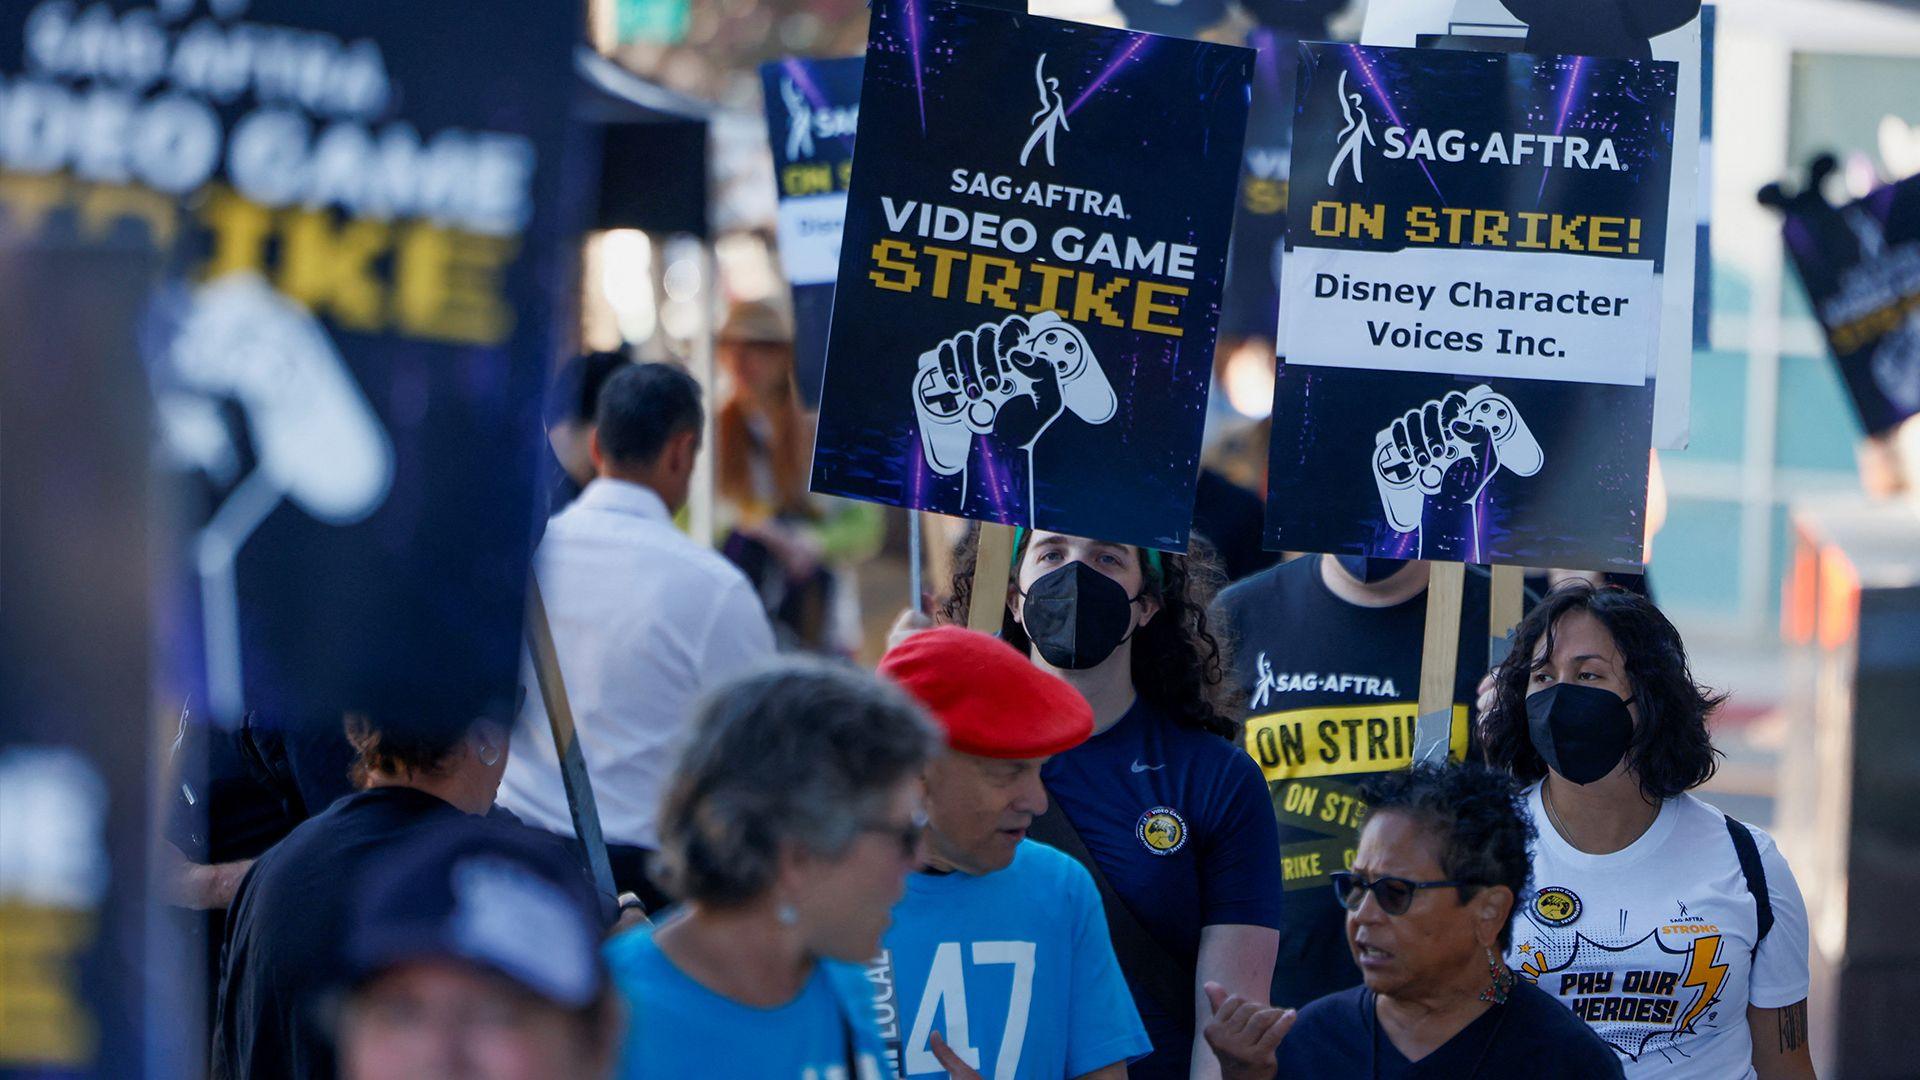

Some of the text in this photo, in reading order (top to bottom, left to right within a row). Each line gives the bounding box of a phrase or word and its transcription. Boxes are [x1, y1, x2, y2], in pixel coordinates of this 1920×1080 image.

[880, 196, 1198, 280] VIDEO GAME
[1310, 200, 1642, 254] ON STRIKE!
[868, 238, 1190, 337] STRIKE
[1314, 273, 1629, 317] Disney Character
[1366, 320, 1566, 358] Voices Inc.
[1256, 715, 1417, 768] ON STRI
[1284, 783, 1319, 816] ON
[1281, 853, 1323, 881] RIKE
[1661, 924, 1719, 935] STRONG
[1559, 970, 1679, 996] PAY OUR
[905, 940, 1037, 1080] 47
[1571, 997, 1680, 1024] HEROES!
